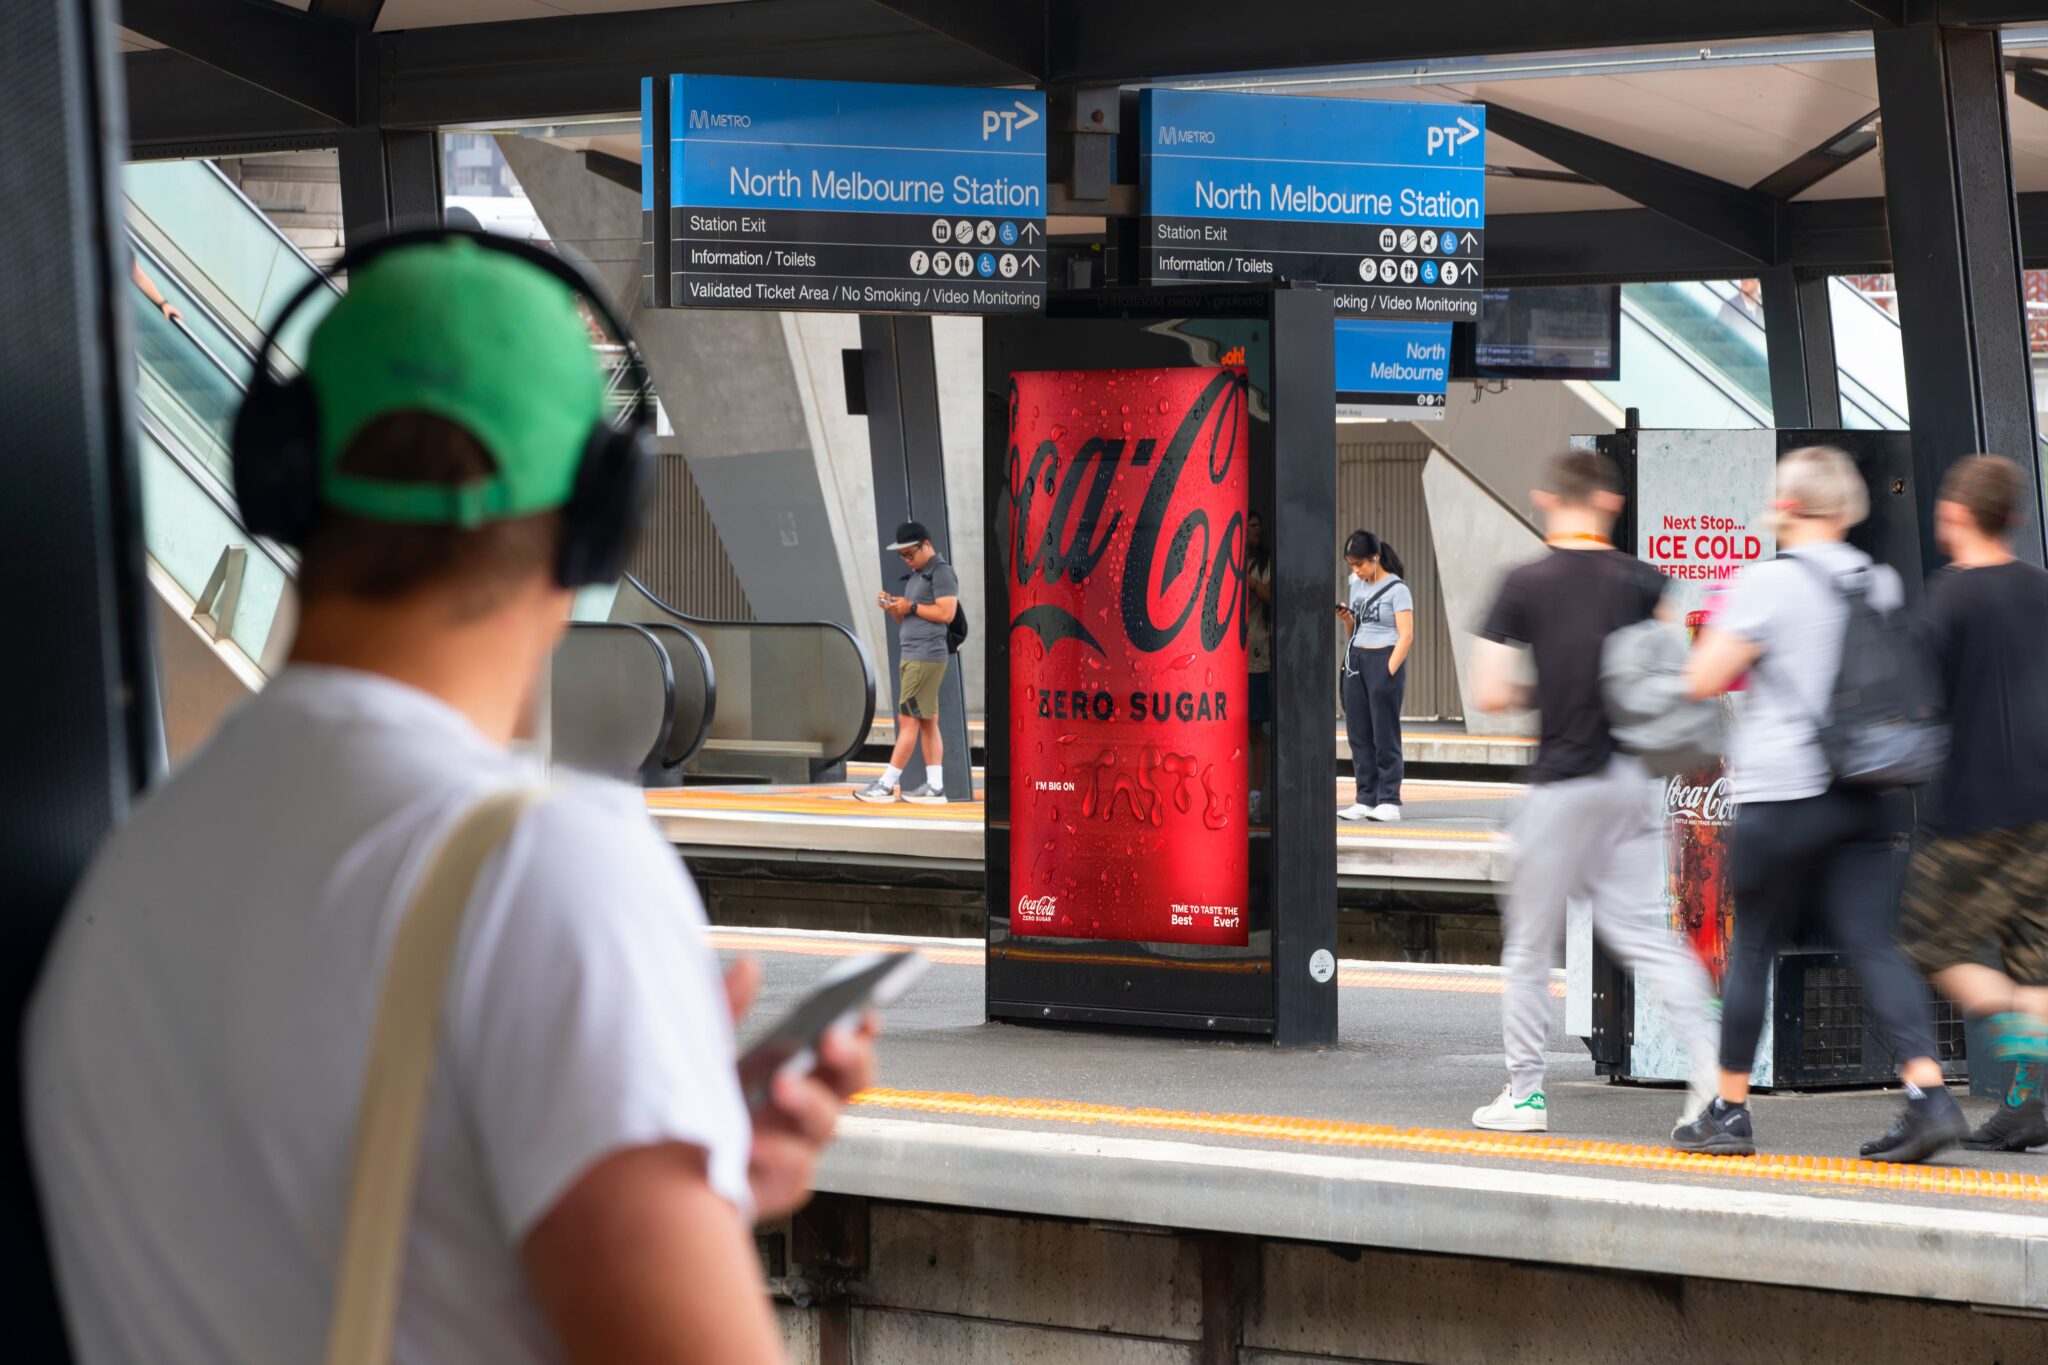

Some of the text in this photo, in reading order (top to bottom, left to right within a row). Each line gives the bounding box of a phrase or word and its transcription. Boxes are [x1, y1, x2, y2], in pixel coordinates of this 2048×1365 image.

[710, 114, 751, 128] METRO
[1178, 131, 1216, 144] METRO
[729, 166, 1040, 207] North Melbourne Station
[1195, 180, 1479, 219] North Melbourne Station
[690, 215, 767, 233] Station Exit
[1158, 223, 1228, 241] Station Exit
[691, 248, 817, 267] Information / Toilets
[1159, 255, 1274, 274] Information / Toilets
[689, 281, 1041, 309] Validated Ticket Area / No Smoking / Video Monitoring
[1333, 294, 1477, 316] oking / Video Monitoring
[1406, 341, 1446, 360] North
[1370, 361, 1445, 381] Melbourne
[1663, 515, 1746, 533] Next Stop...
[1648, 535, 1761, 560] ICE COLD
[1038, 689, 1228, 723] ZERO SUGAR
[1035, 781, 1075, 792] I'M BIG ON
[1018, 894, 1058, 916] Coca-Cola
[1171, 904, 1239, 916] TIME TO TASTE THE
[1171, 914, 1240, 928] Best Ever?
